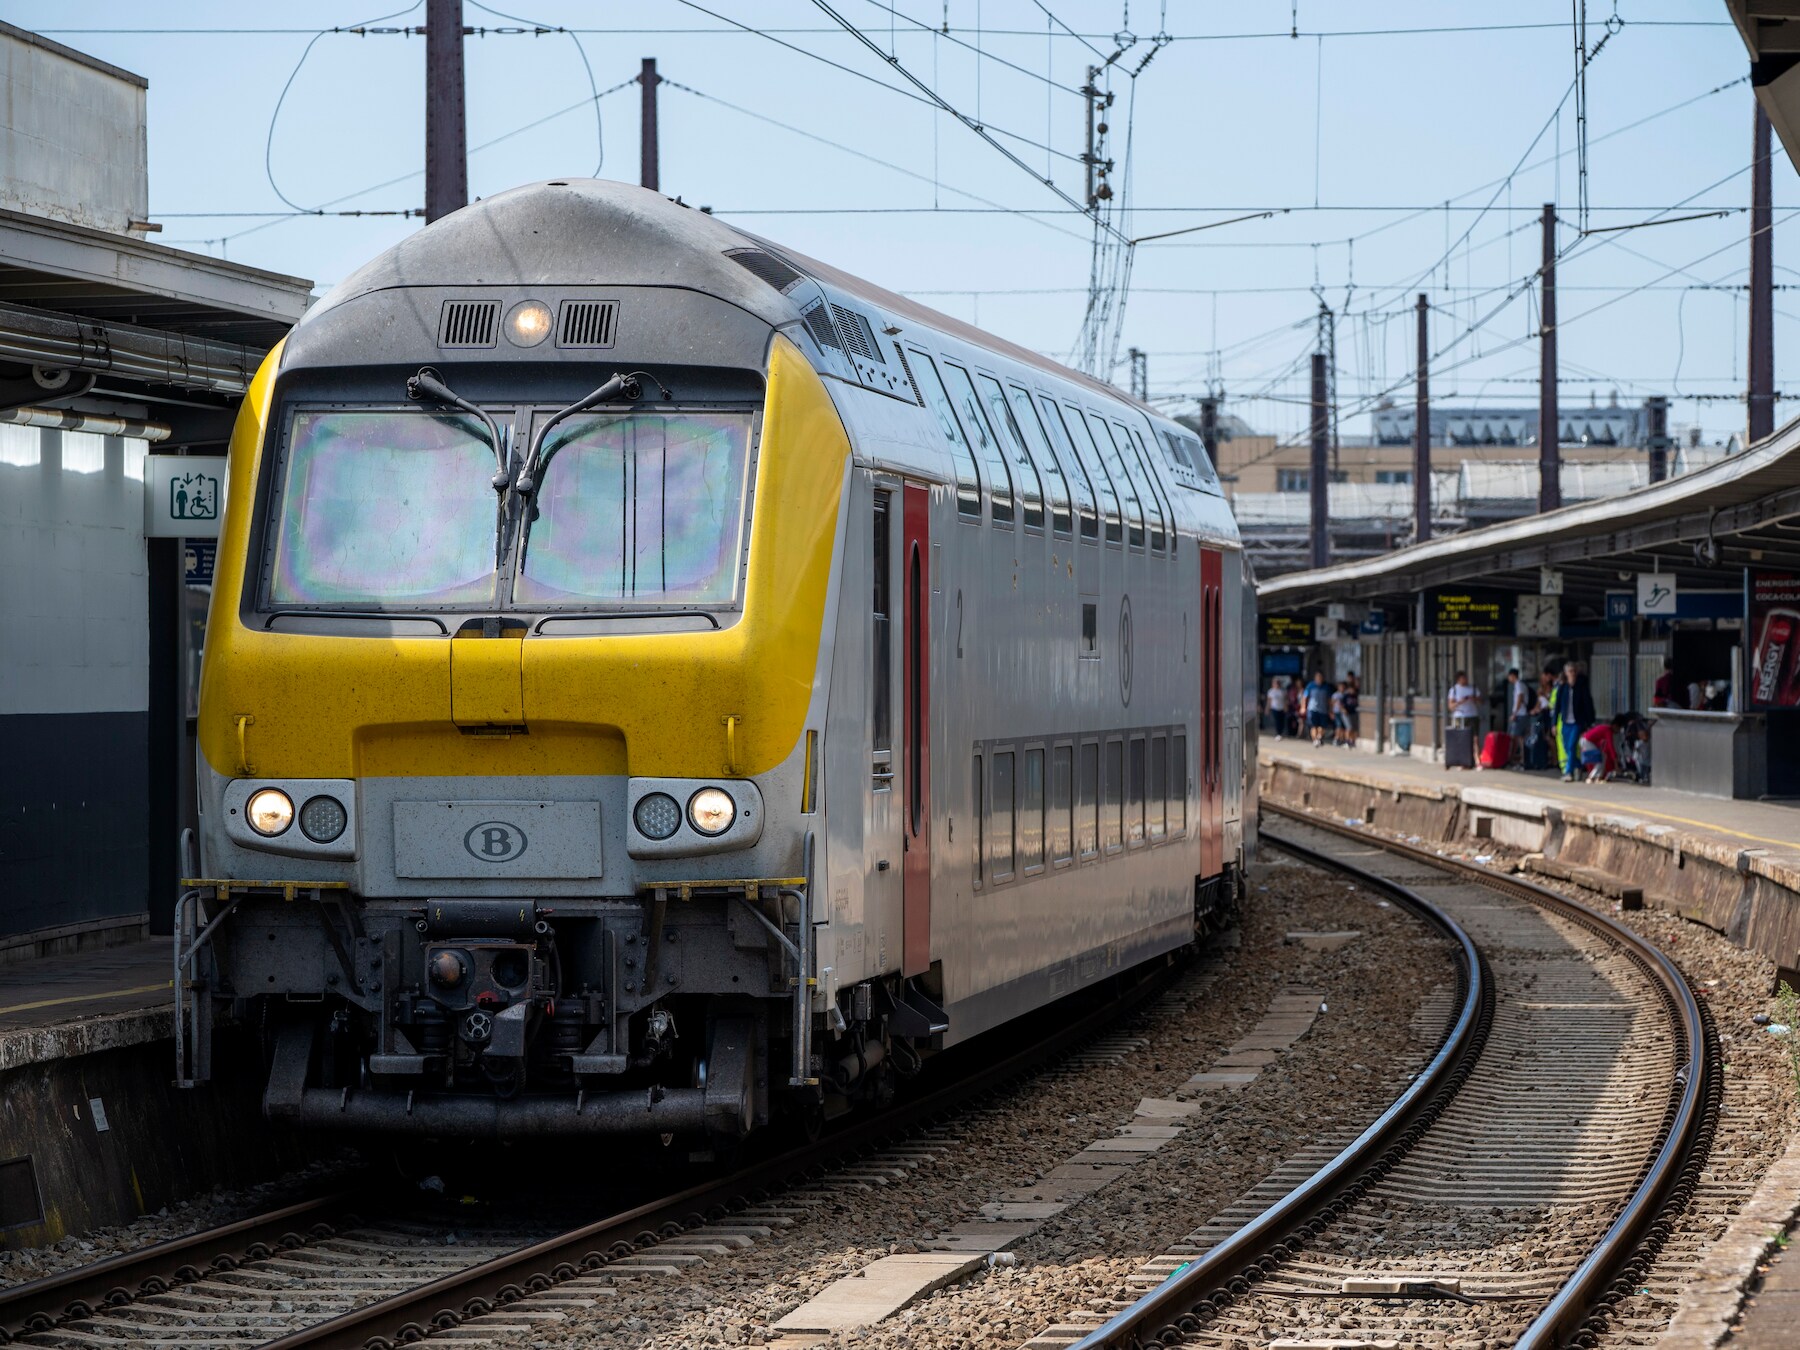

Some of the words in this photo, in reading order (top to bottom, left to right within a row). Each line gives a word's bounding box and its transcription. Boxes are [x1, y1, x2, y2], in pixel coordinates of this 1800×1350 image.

[956, 588, 963, 659] 2
[1614, 603, 1626, 614] 10
[1757, 641, 1780, 700] ENERGY
[480, 827, 512, 857] B
